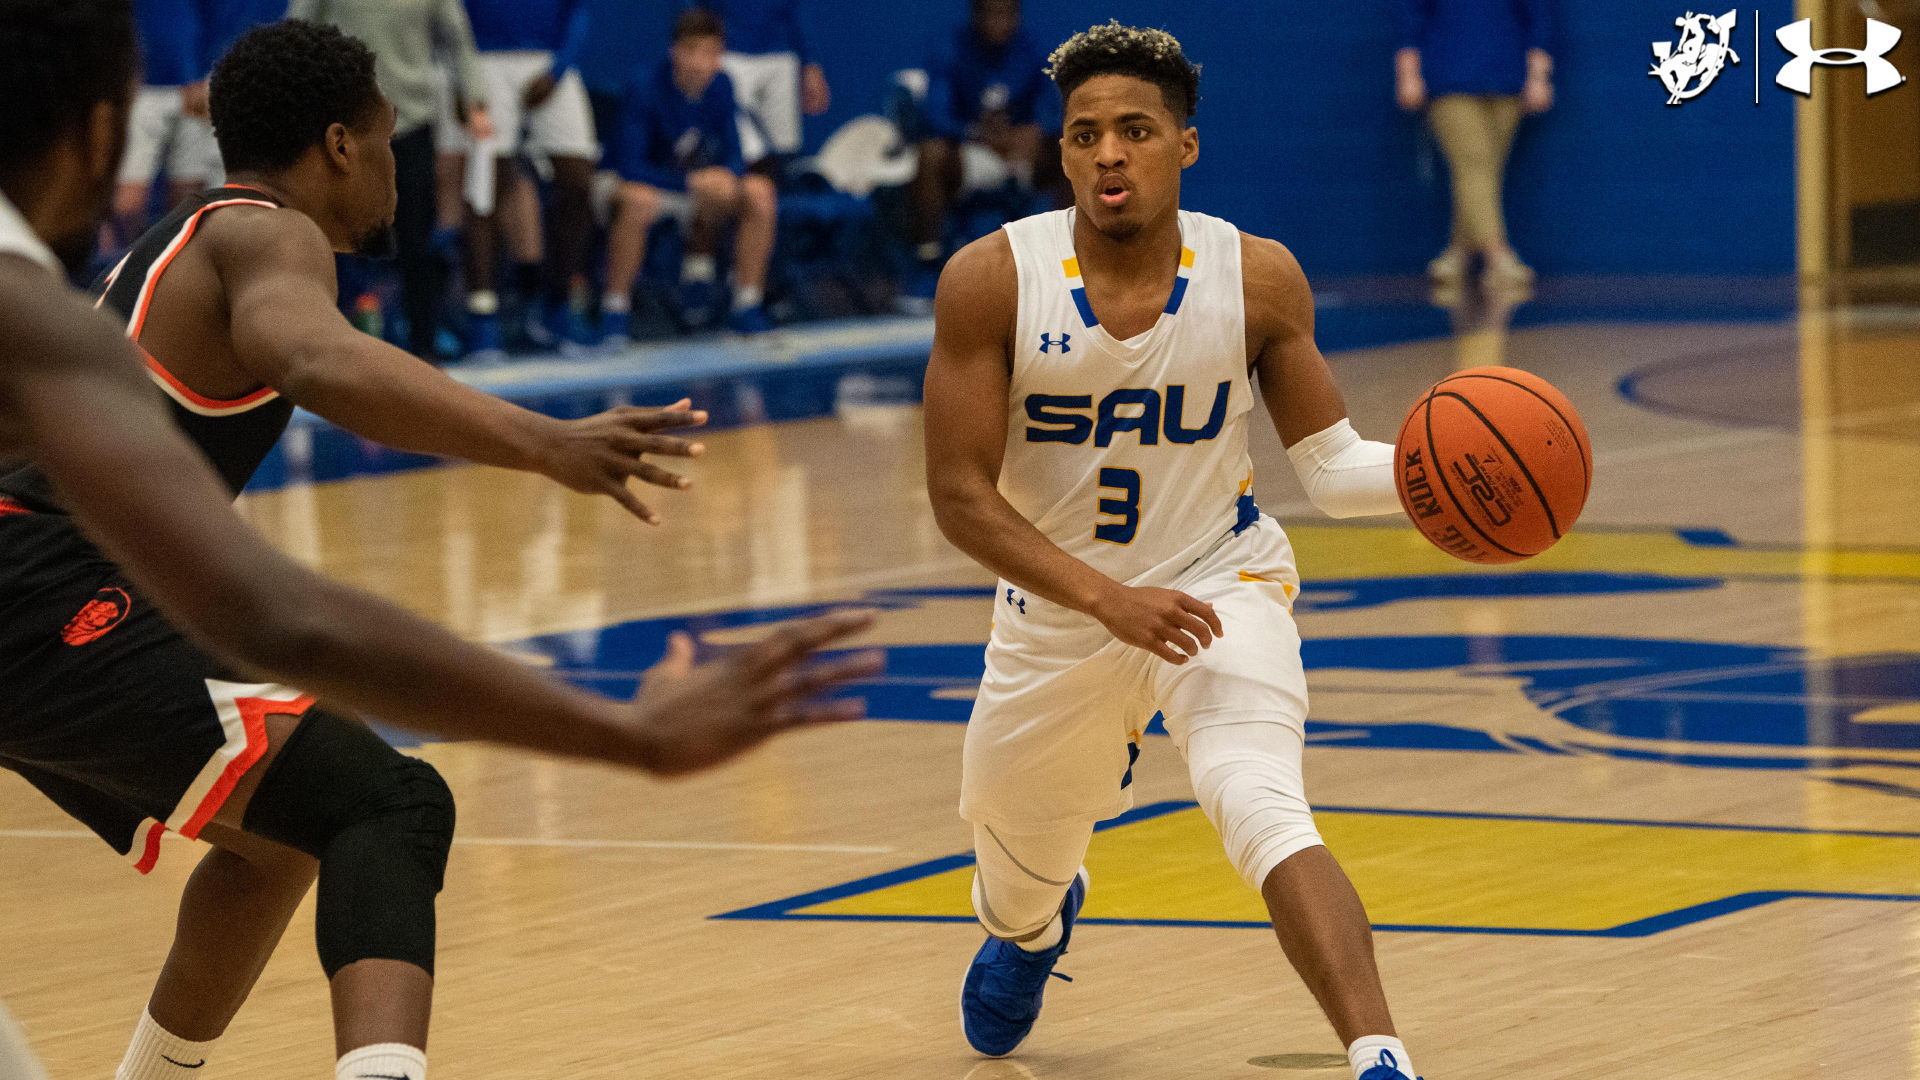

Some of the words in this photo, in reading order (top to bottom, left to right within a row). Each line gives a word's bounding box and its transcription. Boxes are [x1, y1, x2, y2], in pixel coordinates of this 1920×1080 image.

[1023, 379, 1233, 448] SAU
[1093, 467, 1142, 546] 3
[1405, 446, 1444, 520] ROCK
[1433, 524, 1489, 561] THE
